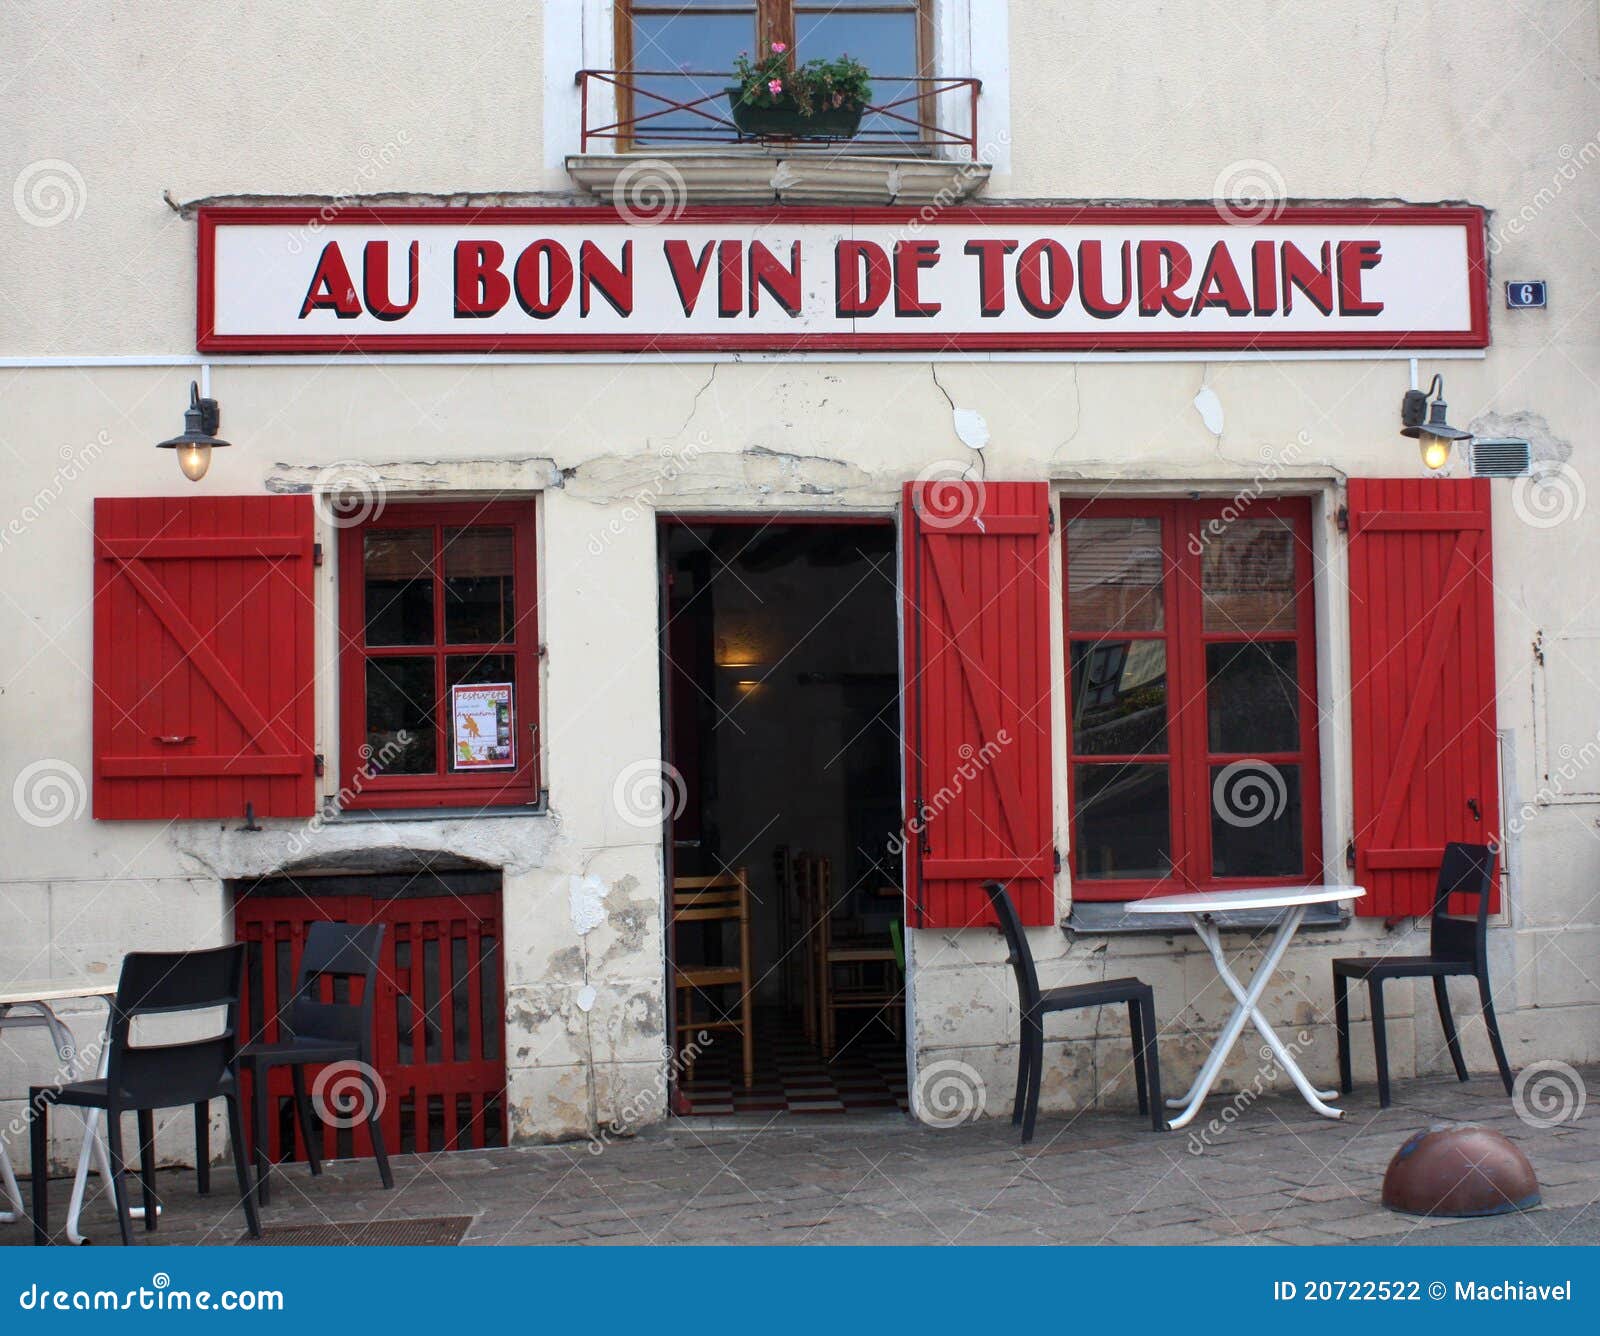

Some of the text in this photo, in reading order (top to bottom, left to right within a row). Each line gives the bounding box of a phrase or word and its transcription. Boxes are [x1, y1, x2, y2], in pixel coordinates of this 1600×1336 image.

[298, 238, 1384, 322] AU BON VIN DE TOURAINE
[1521, 285, 1533, 304] 6
